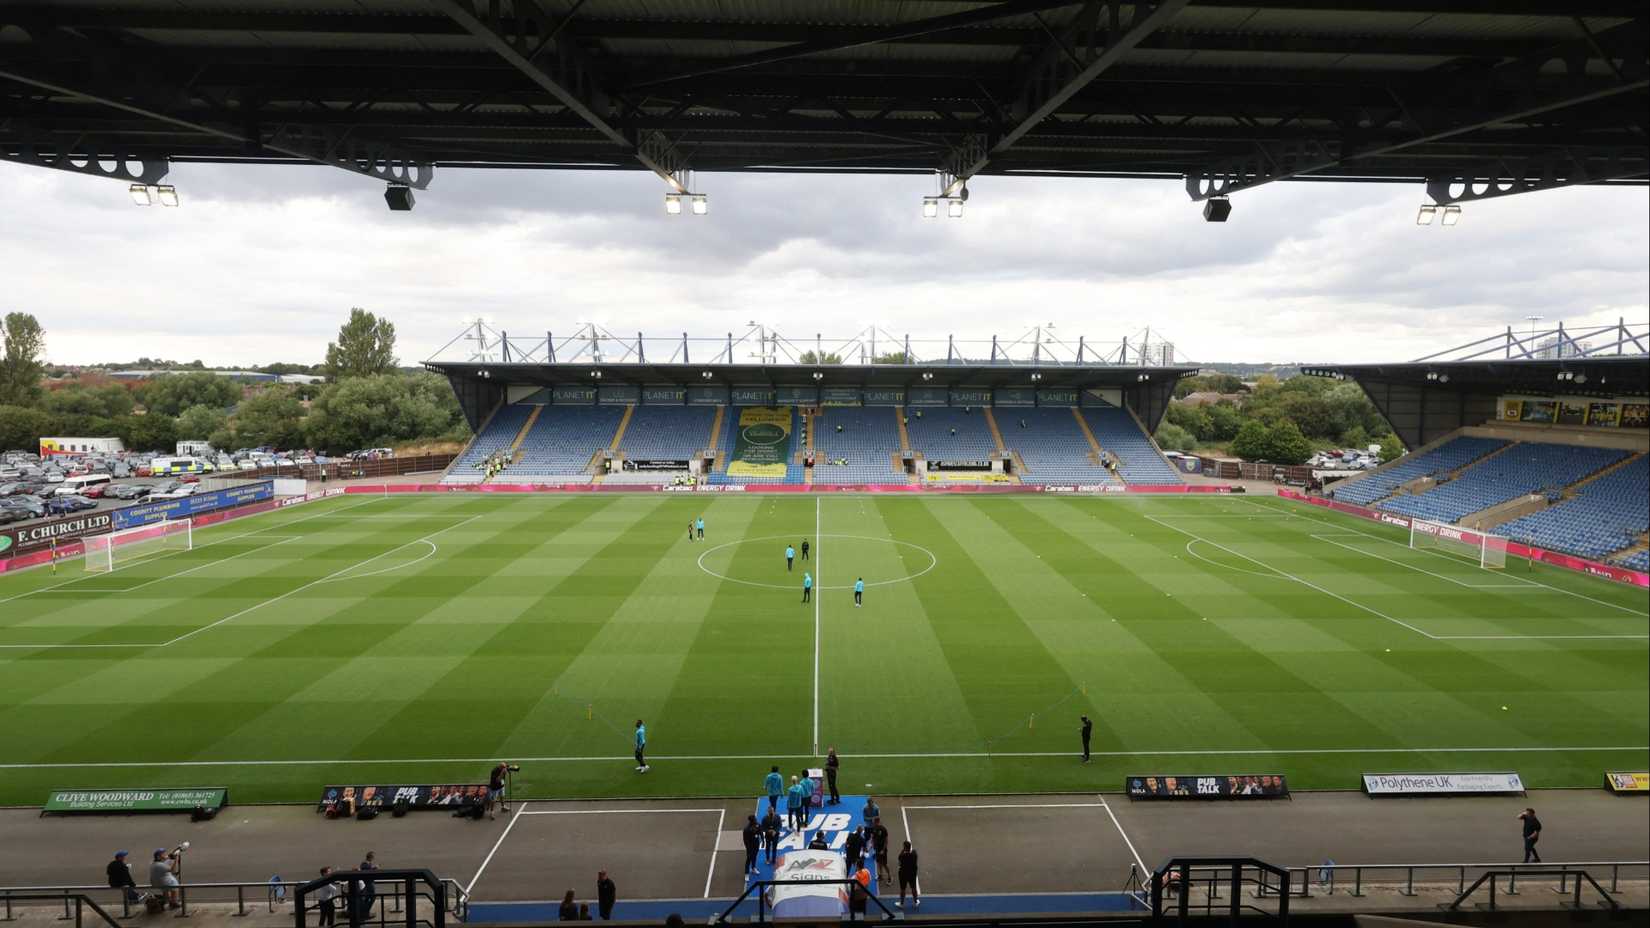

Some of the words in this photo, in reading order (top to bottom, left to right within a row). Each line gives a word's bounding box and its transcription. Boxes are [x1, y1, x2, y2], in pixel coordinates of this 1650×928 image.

[31, 520, 85, 540] CHURCH
[87, 515, 110, 526] LTD
[1197, 778, 1216, 787] PUB
[1379, 777, 1434, 790] Polythene
[1435, 776, 1454, 788] UK
[397, 787, 419, 798] PUB
[1198, 785, 1220, 794] TALK
[56, 793, 90, 801] CLIVE
[90, 792, 154, 801] WOODWARD
